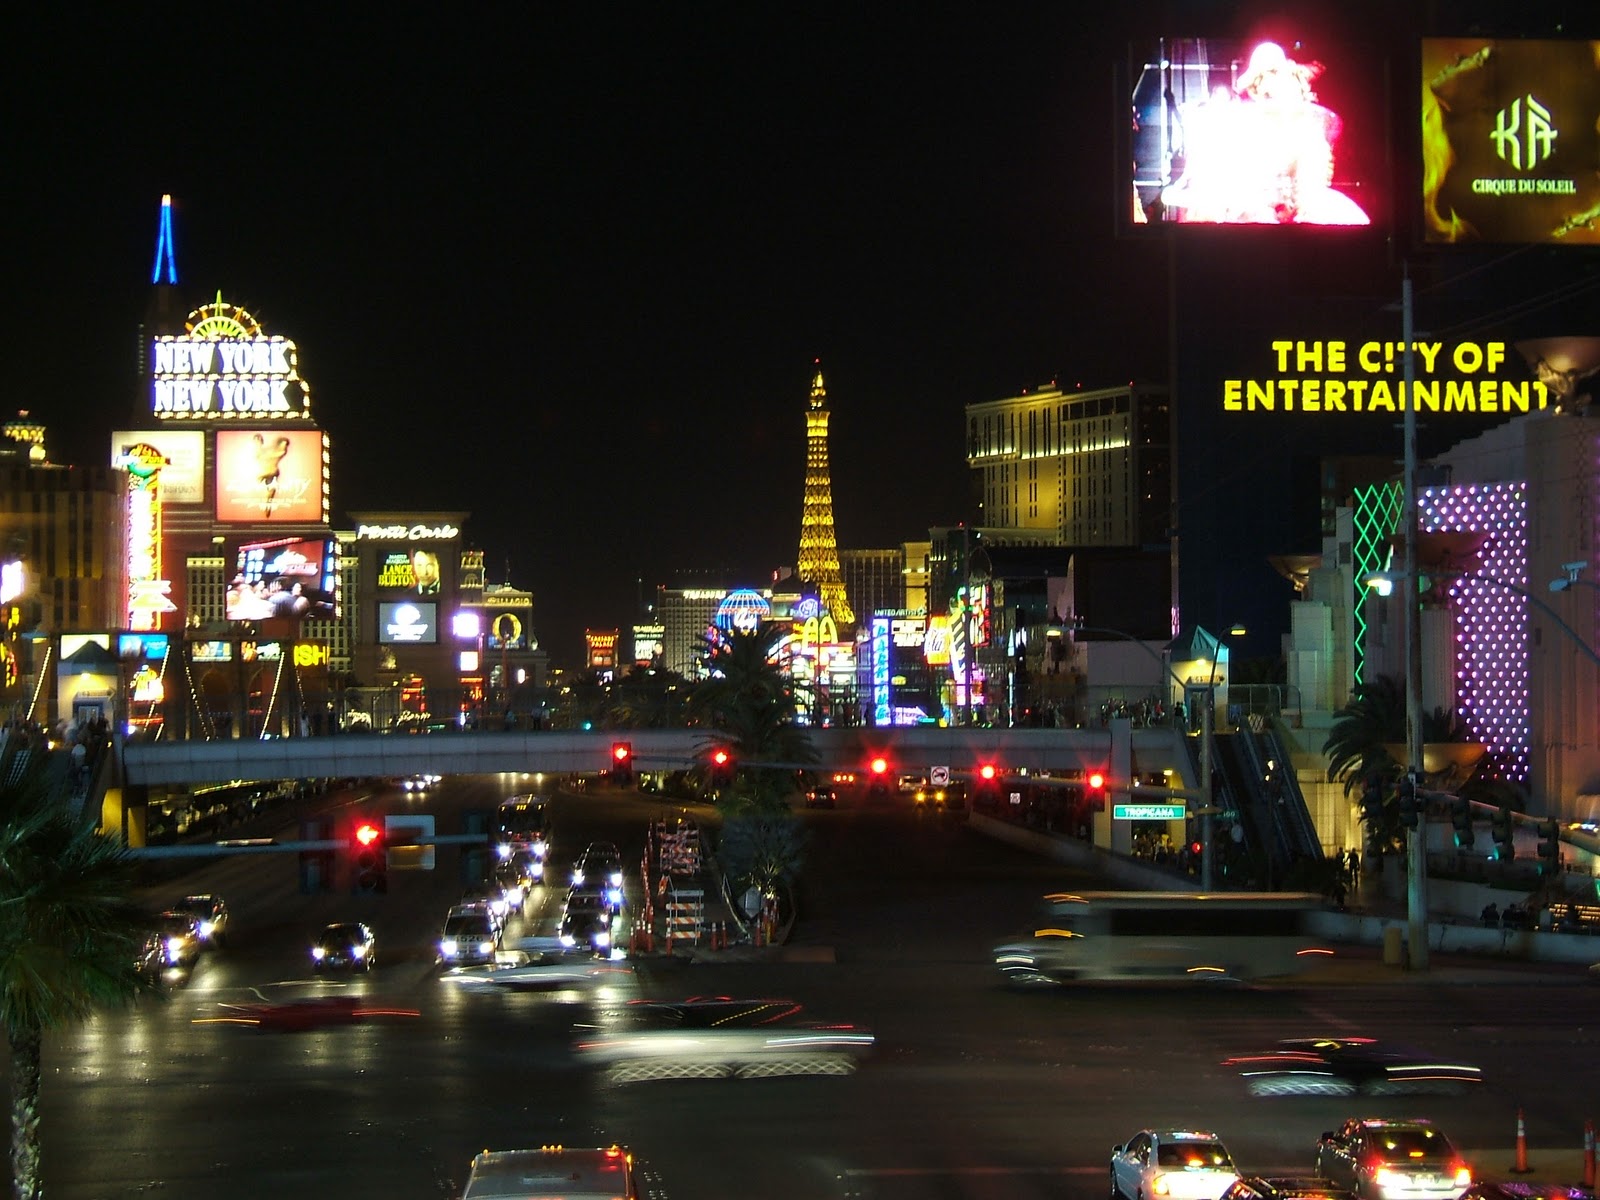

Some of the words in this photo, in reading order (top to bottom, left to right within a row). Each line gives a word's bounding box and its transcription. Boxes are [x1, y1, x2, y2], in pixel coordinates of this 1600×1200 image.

[1472, 179, 1517, 197] CIRQUE
[1518, 179, 1536, 194] DU
[1536, 179, 1577, 194] SOLEIL
[154, 342, 215, 374] NEW
[218, 342, 291, 374] YORK
[1272, 341, 1346, 373] THE
[1453, 341, 1505, 374] OF
[154, 380, 215, 412] NEW
[218, 380, 291, 412] YORK
[357, 525, 409, 540] Monte
[408, 524, 459, 540] Carlo
[383, 564, 413, 575] LANCE
[378, 574, 416, 587] BURTON
[874, 608, 896, 617] UNITED
[1124, 807, 1175, 817] TROPICANA
